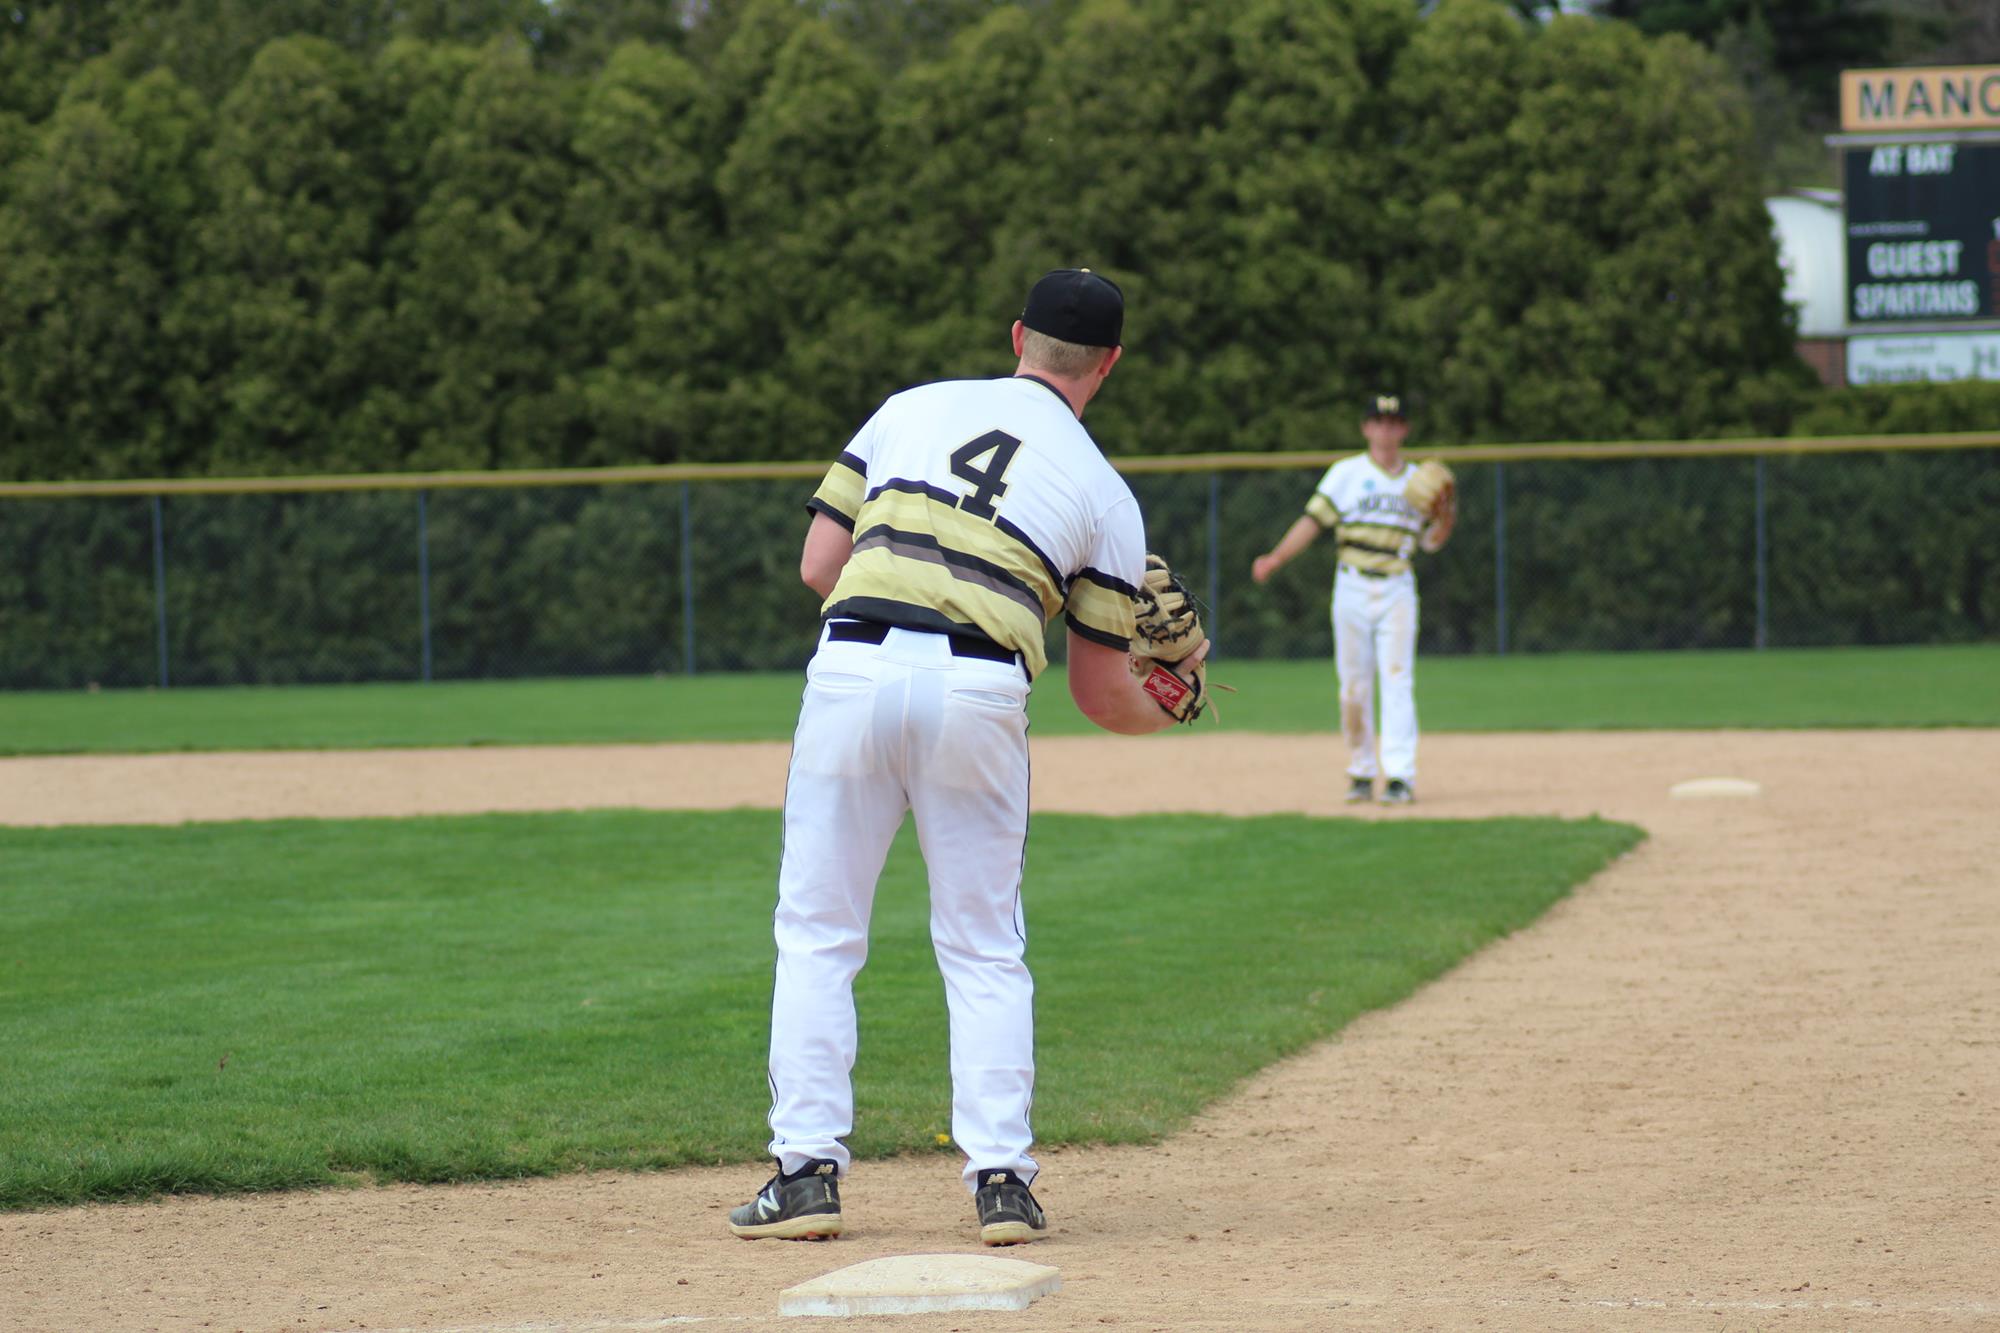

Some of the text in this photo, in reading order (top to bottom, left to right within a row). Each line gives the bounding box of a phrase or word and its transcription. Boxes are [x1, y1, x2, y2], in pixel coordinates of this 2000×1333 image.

[1869, 143, 1955, 176] AT BAT
[1867, 241, 1962, 278] GUEST
[1854, 280, 1979, 318] SPARTANS
[949, 427, 1024, 526] 4
